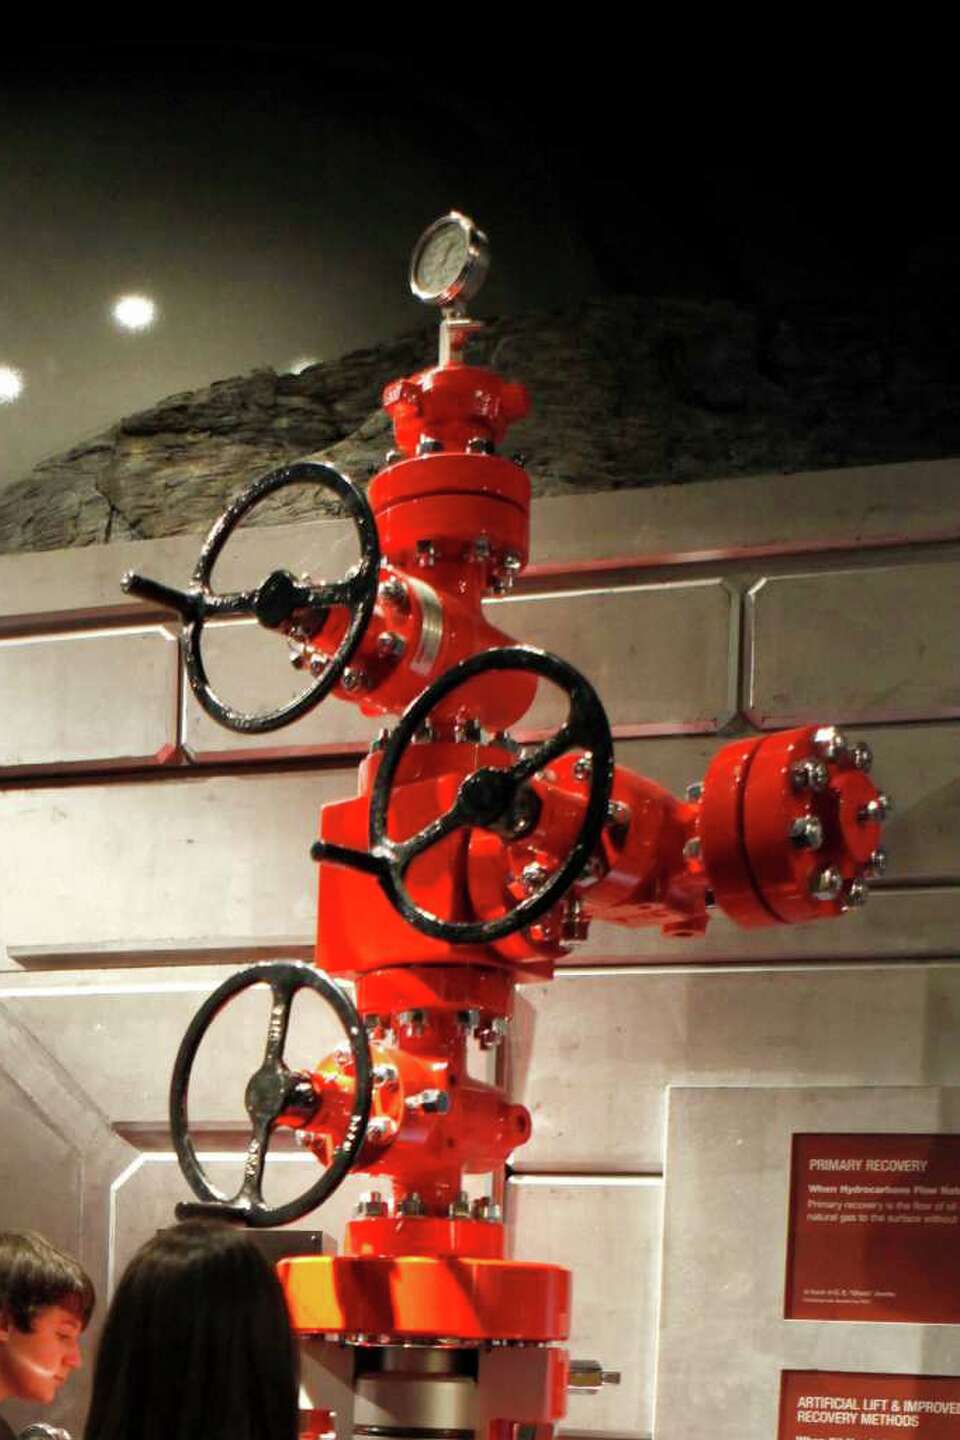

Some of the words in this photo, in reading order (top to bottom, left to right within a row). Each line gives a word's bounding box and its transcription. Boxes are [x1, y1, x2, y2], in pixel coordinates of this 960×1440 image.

[809, 1159, 862, 1171] PRIMARY
[866, 1160, 928, 1172] RECOVERY
[808, 1185, 838, 1194] When
[840, 1185, 911, 1195] Hydrocarbons
[798, 1397, 860, 1410] ARTIFICIAL
[864, 1399, 889, 1411] LIFT
[892, 1400, 901, 1412] &
[798, 1411, 858, 1425] RECOVERY
[861, 1414, 920, 1427] METHODS
